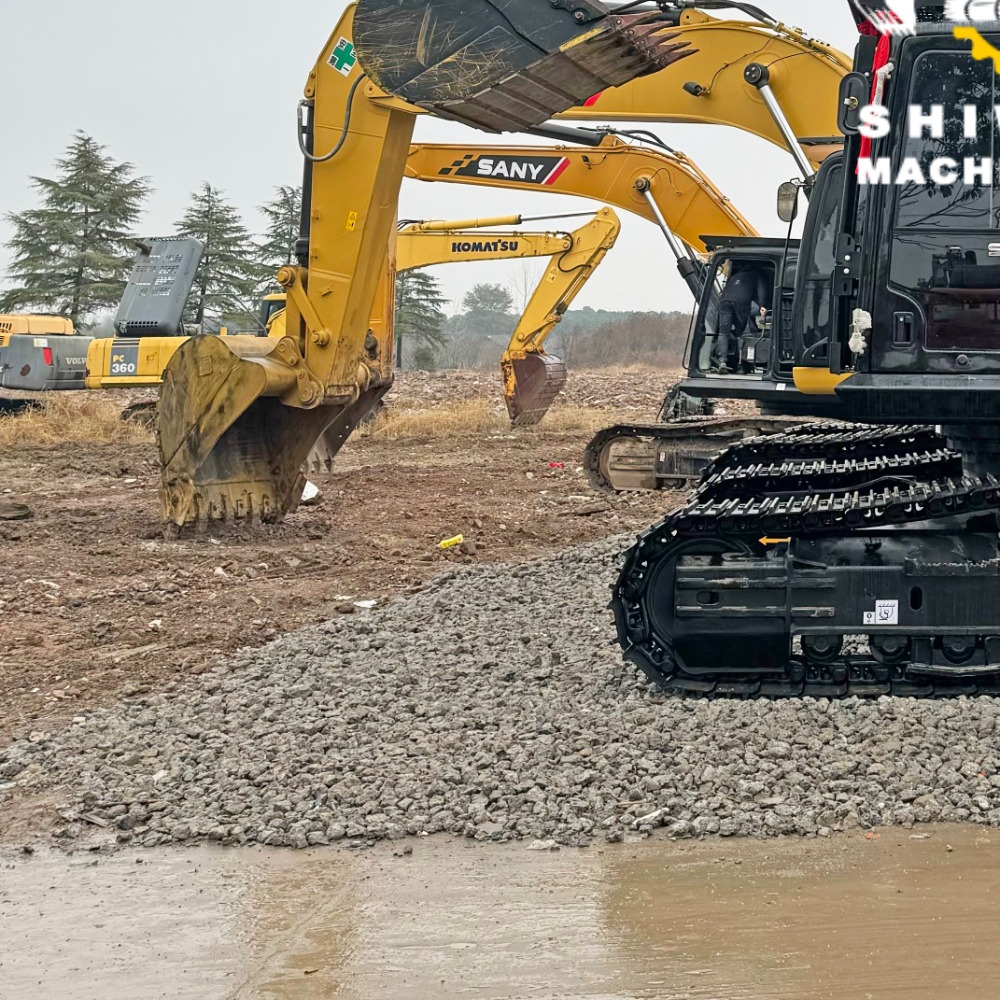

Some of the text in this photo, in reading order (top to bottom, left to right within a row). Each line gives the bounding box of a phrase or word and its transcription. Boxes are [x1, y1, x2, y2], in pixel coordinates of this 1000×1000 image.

[476, 158, 544, 180] SANY
[452, 241, 518, 252] KOMATSU
[111, 363, 136, 373] 360
